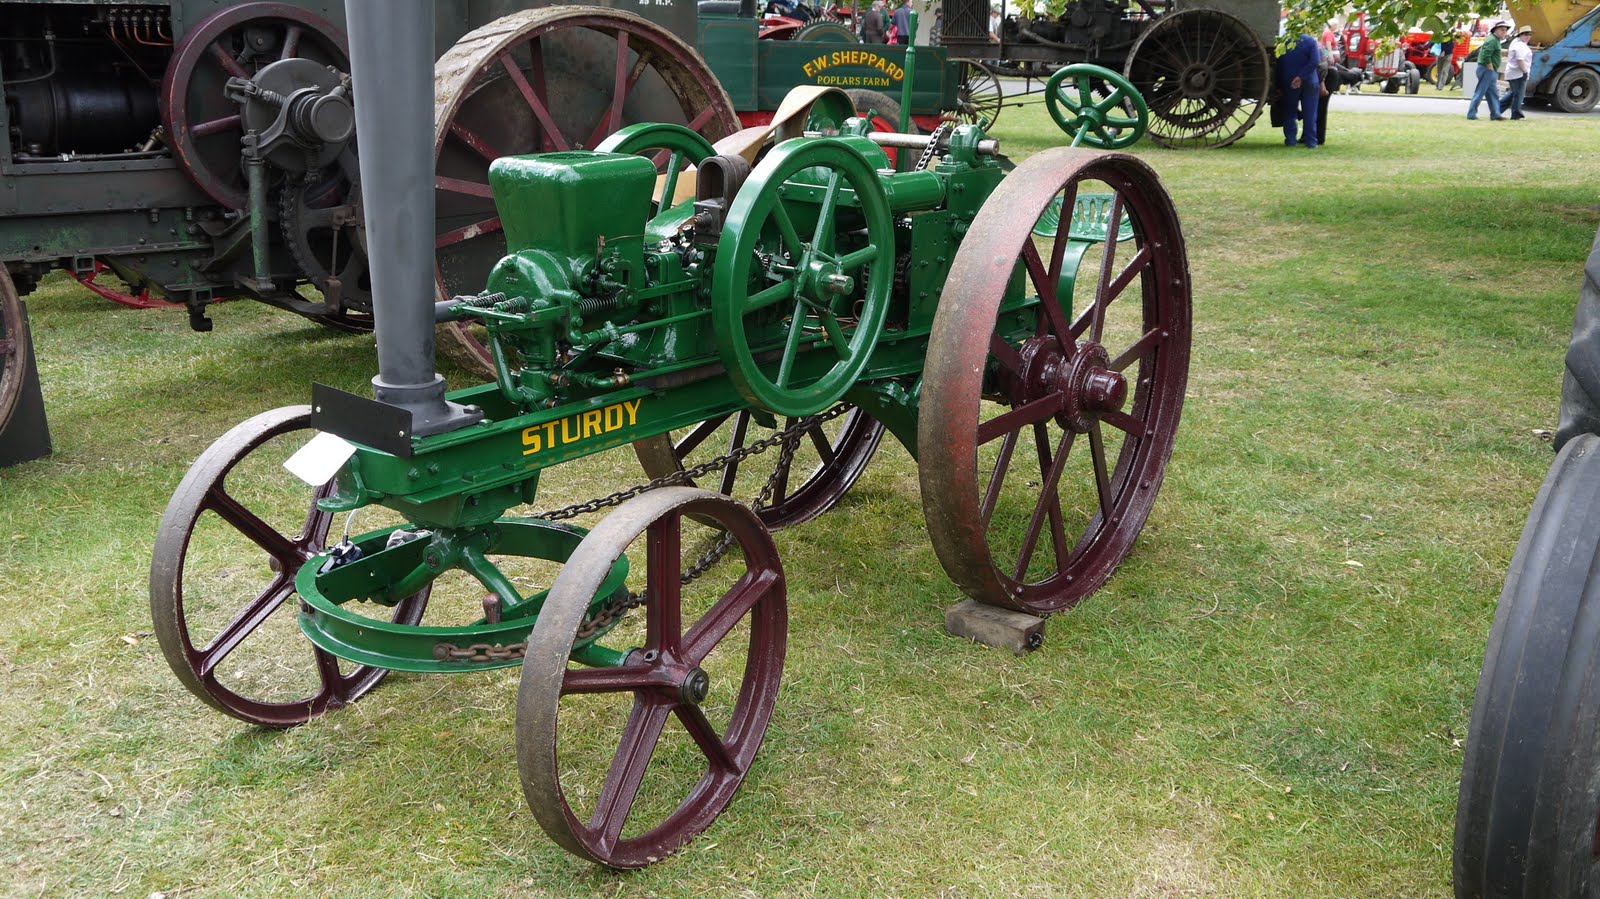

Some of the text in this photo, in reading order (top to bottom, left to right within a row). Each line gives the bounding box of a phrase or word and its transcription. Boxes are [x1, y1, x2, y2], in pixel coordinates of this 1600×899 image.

[832, 51, 904, 80] SHEPPARD
[817, 76, 890, 86] POPLARS FARM
[522, 398, 641, 455] STURDY
